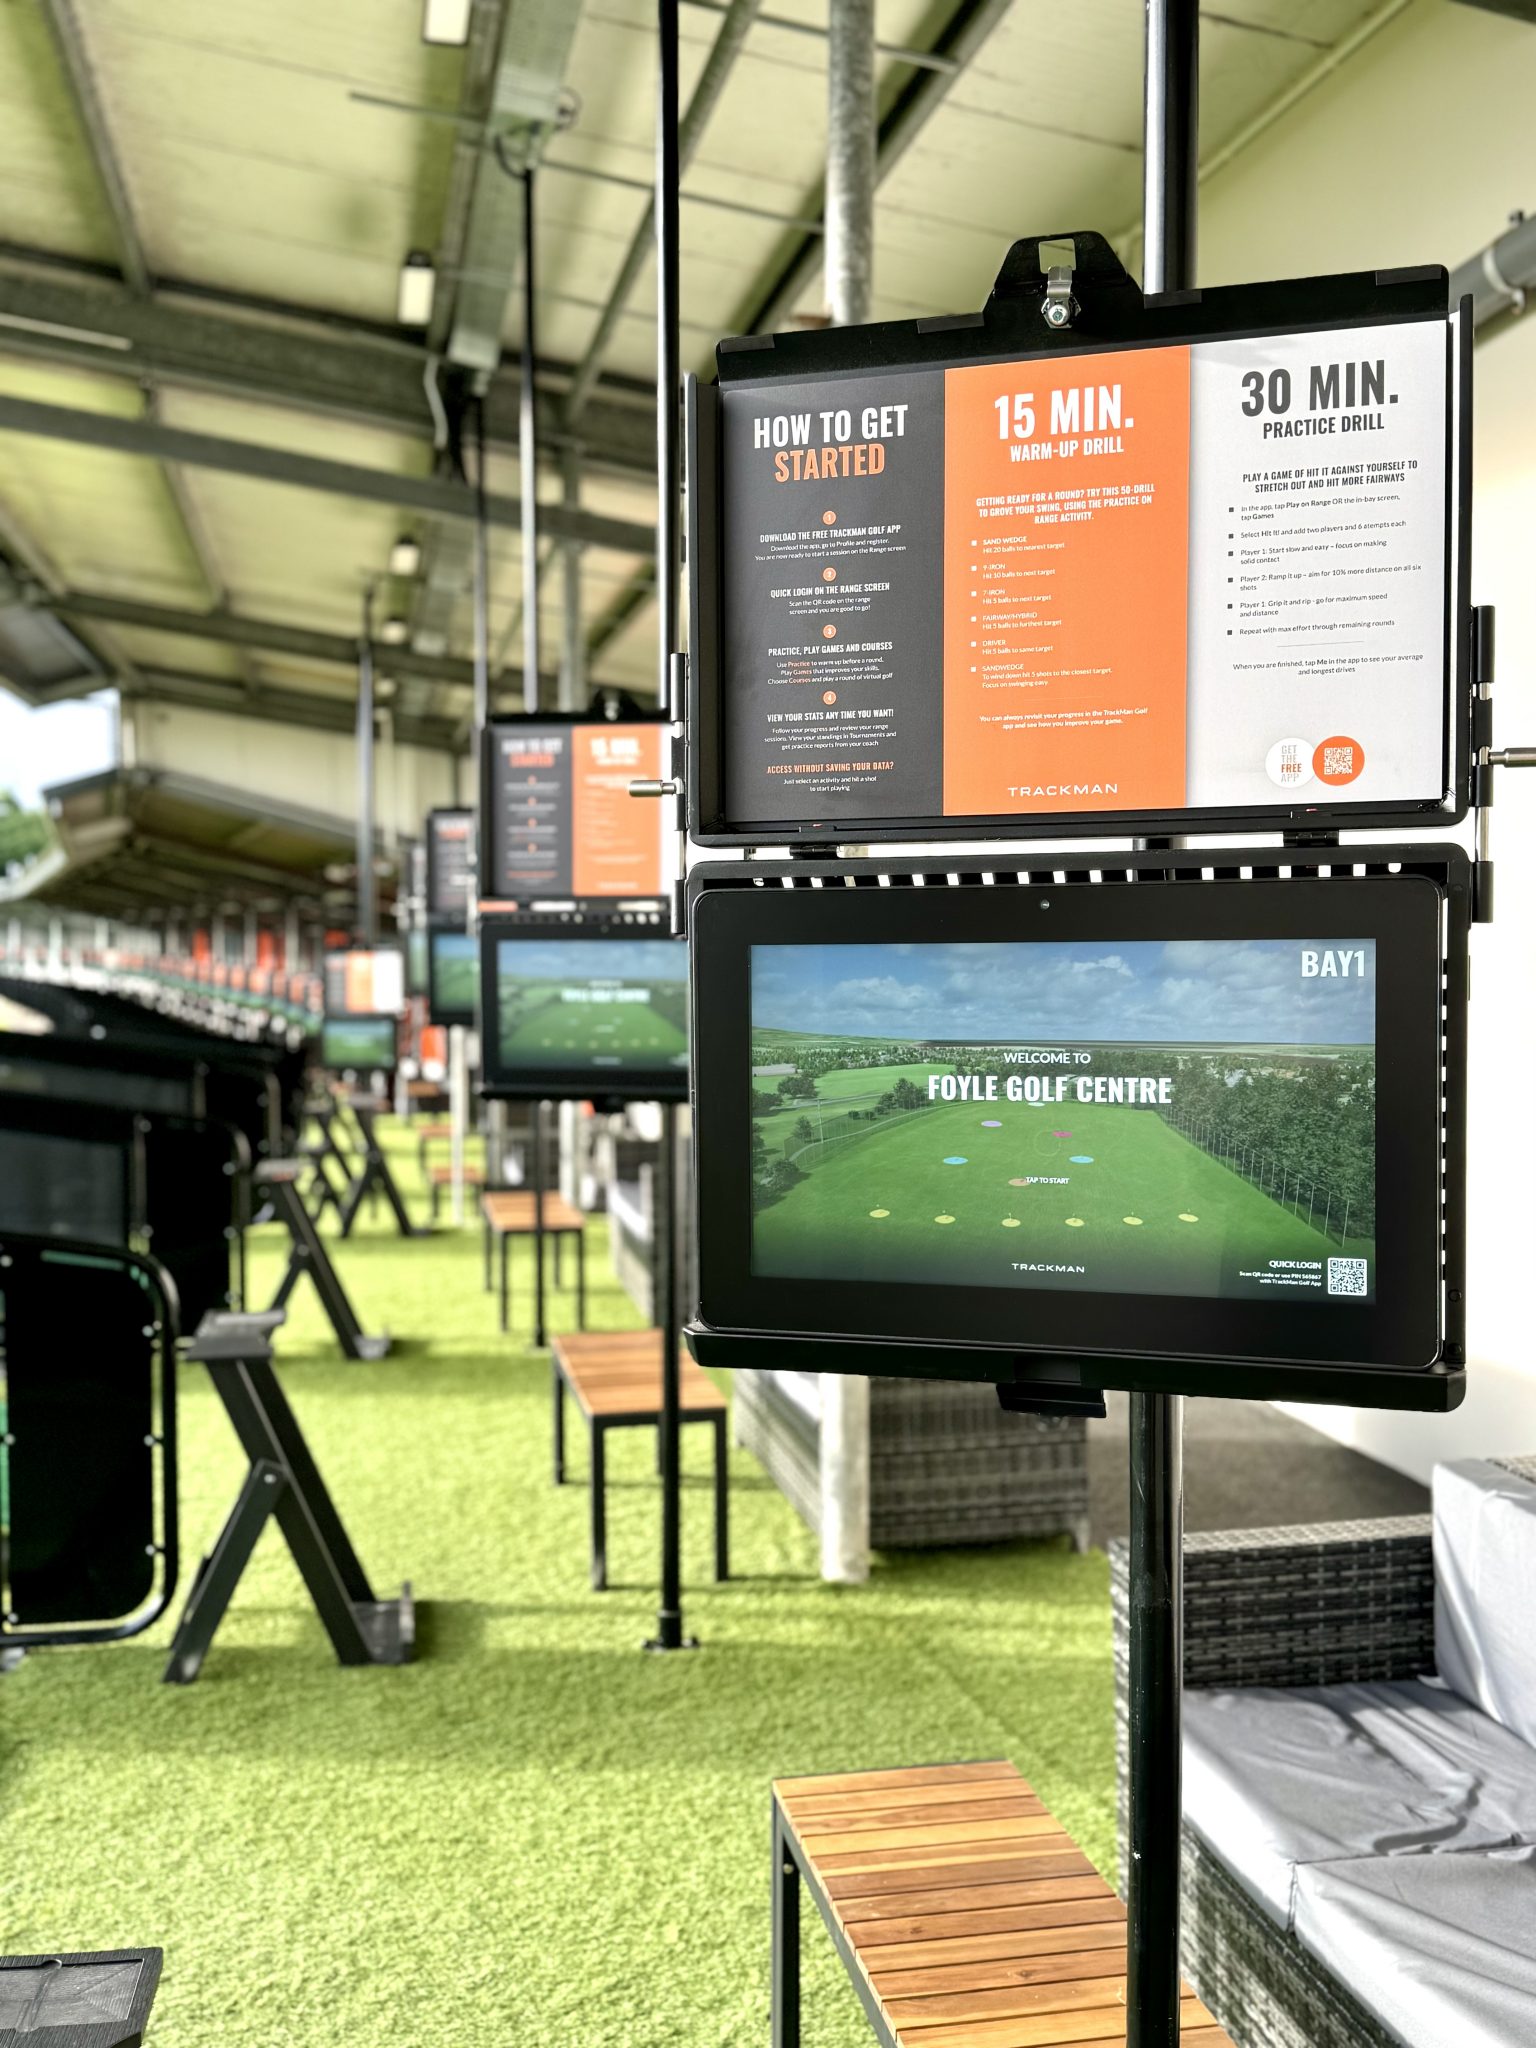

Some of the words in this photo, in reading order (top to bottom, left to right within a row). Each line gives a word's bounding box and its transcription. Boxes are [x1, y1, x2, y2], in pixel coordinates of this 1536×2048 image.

[1242, 368, 1291, 417] 30
[1309, 359, 1398, 411] MIN.
[995, 393, 1035, 439] 15
[1050, 384, 1134, 434] MIN.
[754, 413, 811, 448] HOW
[819, 409, 851, 443] TO
[861, 405, 908, 439] GET
[1264, 417, 1335, 439] PRACTICE
[1341, 413, 1384, 432] DRILL
[1011, 440, 1078, 462] WARM-UP
[1083, 436, 1124, 456] DRILL
[775, 443, 884, 482] STARTED
[1243, 473, 1261, 482] PLAY
[1263, 472, 1269, 480] A
[1270, 470, 1292, 480] GAME
[1294, 469, 1304, 478] OF
[1306, 468, 1319, 477] HIT
[1321, 467, 1328, 476] IT
[1331, 465, 1364, 475] AGAINST
[1366, 461, 1405, 472] YOURSELF
[1407, 460, 1417, 469] TO
[1255, 482, 1288, 492] STRETCH
[1290, 481, 1306, 490] OUT
[1308, 479, 1324, 488] AND
[1326, 478, 1339, 487] HIT
[1341, 476, 1363, 486] MORE
[1366, 473, 1405, 484] FAIRWAYS
[976, 496, 1005, 506] GETTING
[1006, 494, 1030, 504] READY
[1031, 493, 1046, 502] FOR
[1047, 492, 1053, 500] A
[1054, 490, 1084, 500] ROUND?
[1086, 488, 1100, 497] TRY
[1102, 487, 1119, 496] THIS
[979, 509, 988, 517] TO
[989, 507, 1013, 516] GROVE
[1015, 505, 1035, 514] YOUR
[1036, 503, 1062, 514] SWING,
[1063, 501, 1086, 510] USING
[1088, 500, 1101, 508] THE
[1103, 497, 1139, 507] PRACTICE
[1141, 496, 1152, 504] ON
[1035, 515, 1058, 524] RANGE
[1060, 512, 1094, 522] ACTIVITY.
[760, 532, 796, 542] DOWNLOAD
[798, 531, 810, 540] THE
[811, 530, 828, 539] FREE
[829, 527, 866, 538] TRACKMAN
[867, 526, 884, 535] GOLF
[886, 525, 900, 534] APP
[771, 589, 791, 598] QUICK
[793, 587, 813, 596] LOGIN
[814, 587, 824, 595] ON
[826, 586, 838, 594] THE
[840, 584, 862, 593] RANGE
[864, 583, 889, 592] SCREEN
[768, 647, 802, 657] PRACTICE,
[803, 646, 819, 654] PLAY
[821, 645, 844, 653] GAMES
[845, 644, 860, 652] AND
[861, 642, 892, 651] COURSES
[767, 714, 783, 722] VIEW
[784, 713, 803, 721] YOUR
[804, 712, 824, 721] STATS
[825, 711, 838, 720] ANY
[840, 711, 856, 719] TIME
[857, 710, 871, 718] YOU
[873, 709, 893, 718] WANT!
[1282, 745, 1296, 754] GET
[767, 765, 792, 773] ACCESS
[793, 764, 823, 772] WITHOUT
[825, 763, 850, 771] SAVING
[852, 762, 870, 770] YOUR
[872, 761, 893, 770] DATA?
[1282, 755, 1296, 763] THE
[1281, 763, 1301, 772] FREE
[1281, 773, 1299, 782] APP
[1008, 784, 1117, 797] TRACKMAN
[1302, 951, 1365, 977] BAY1
[1004, 1053, 1070, 1064] WELCOME
[1072, 1053, 1091, 1064] TO
[928, 1075, 997, 1101] FOYLE
[1006, 1076, 1067, 1102] GOLF
[1076, 1077, 1171, 1104] CENTRE
[1012, 1263, 1084, 1273] TRACKMAN
[1269, 1261, 1295, 1269] QUICK
